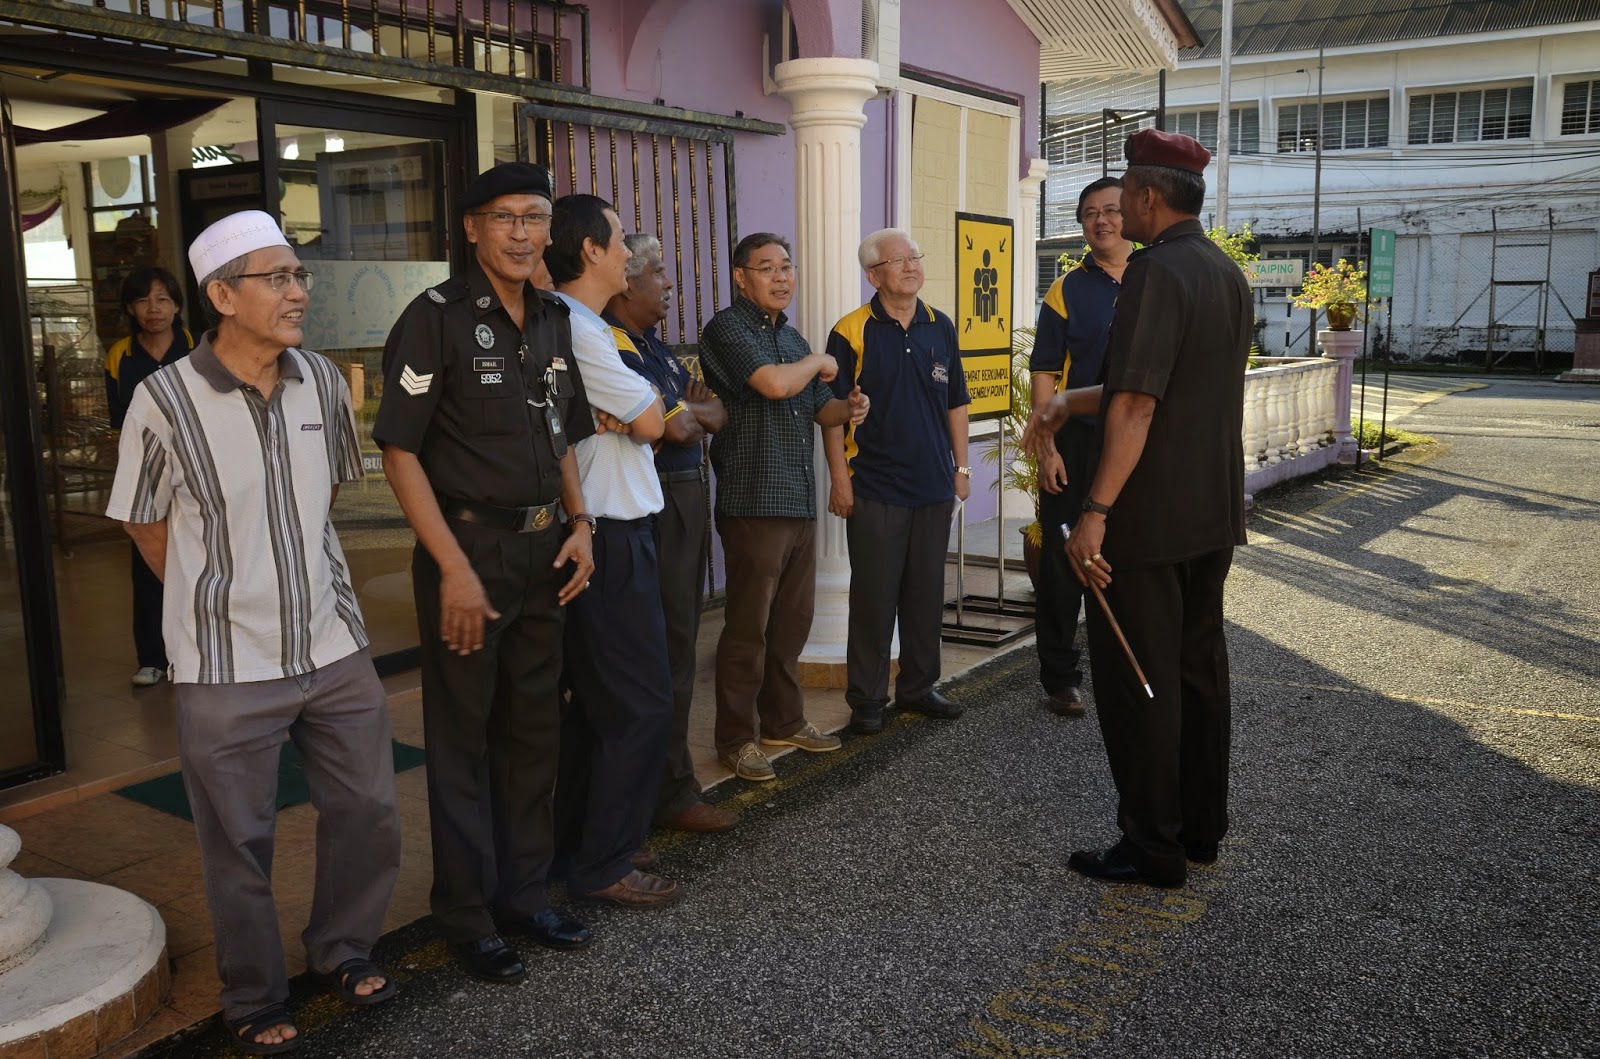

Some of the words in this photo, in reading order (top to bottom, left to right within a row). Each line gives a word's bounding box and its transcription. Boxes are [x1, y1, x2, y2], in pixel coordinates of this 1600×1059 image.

[1255, 263, 1294, 274] TAIPING
[347, 265, 369, 302] PENJARA
[374, 265, 395, 298] TAIPING
[481, 373, 503, 384] 5952
[963, 369, 980, 383] EMPAT
[982, 367, 1009, 381] BERKUMPUL
[969, 387, 990, 399] SEMBLY
[990, 384, 1009, 397] POINT
